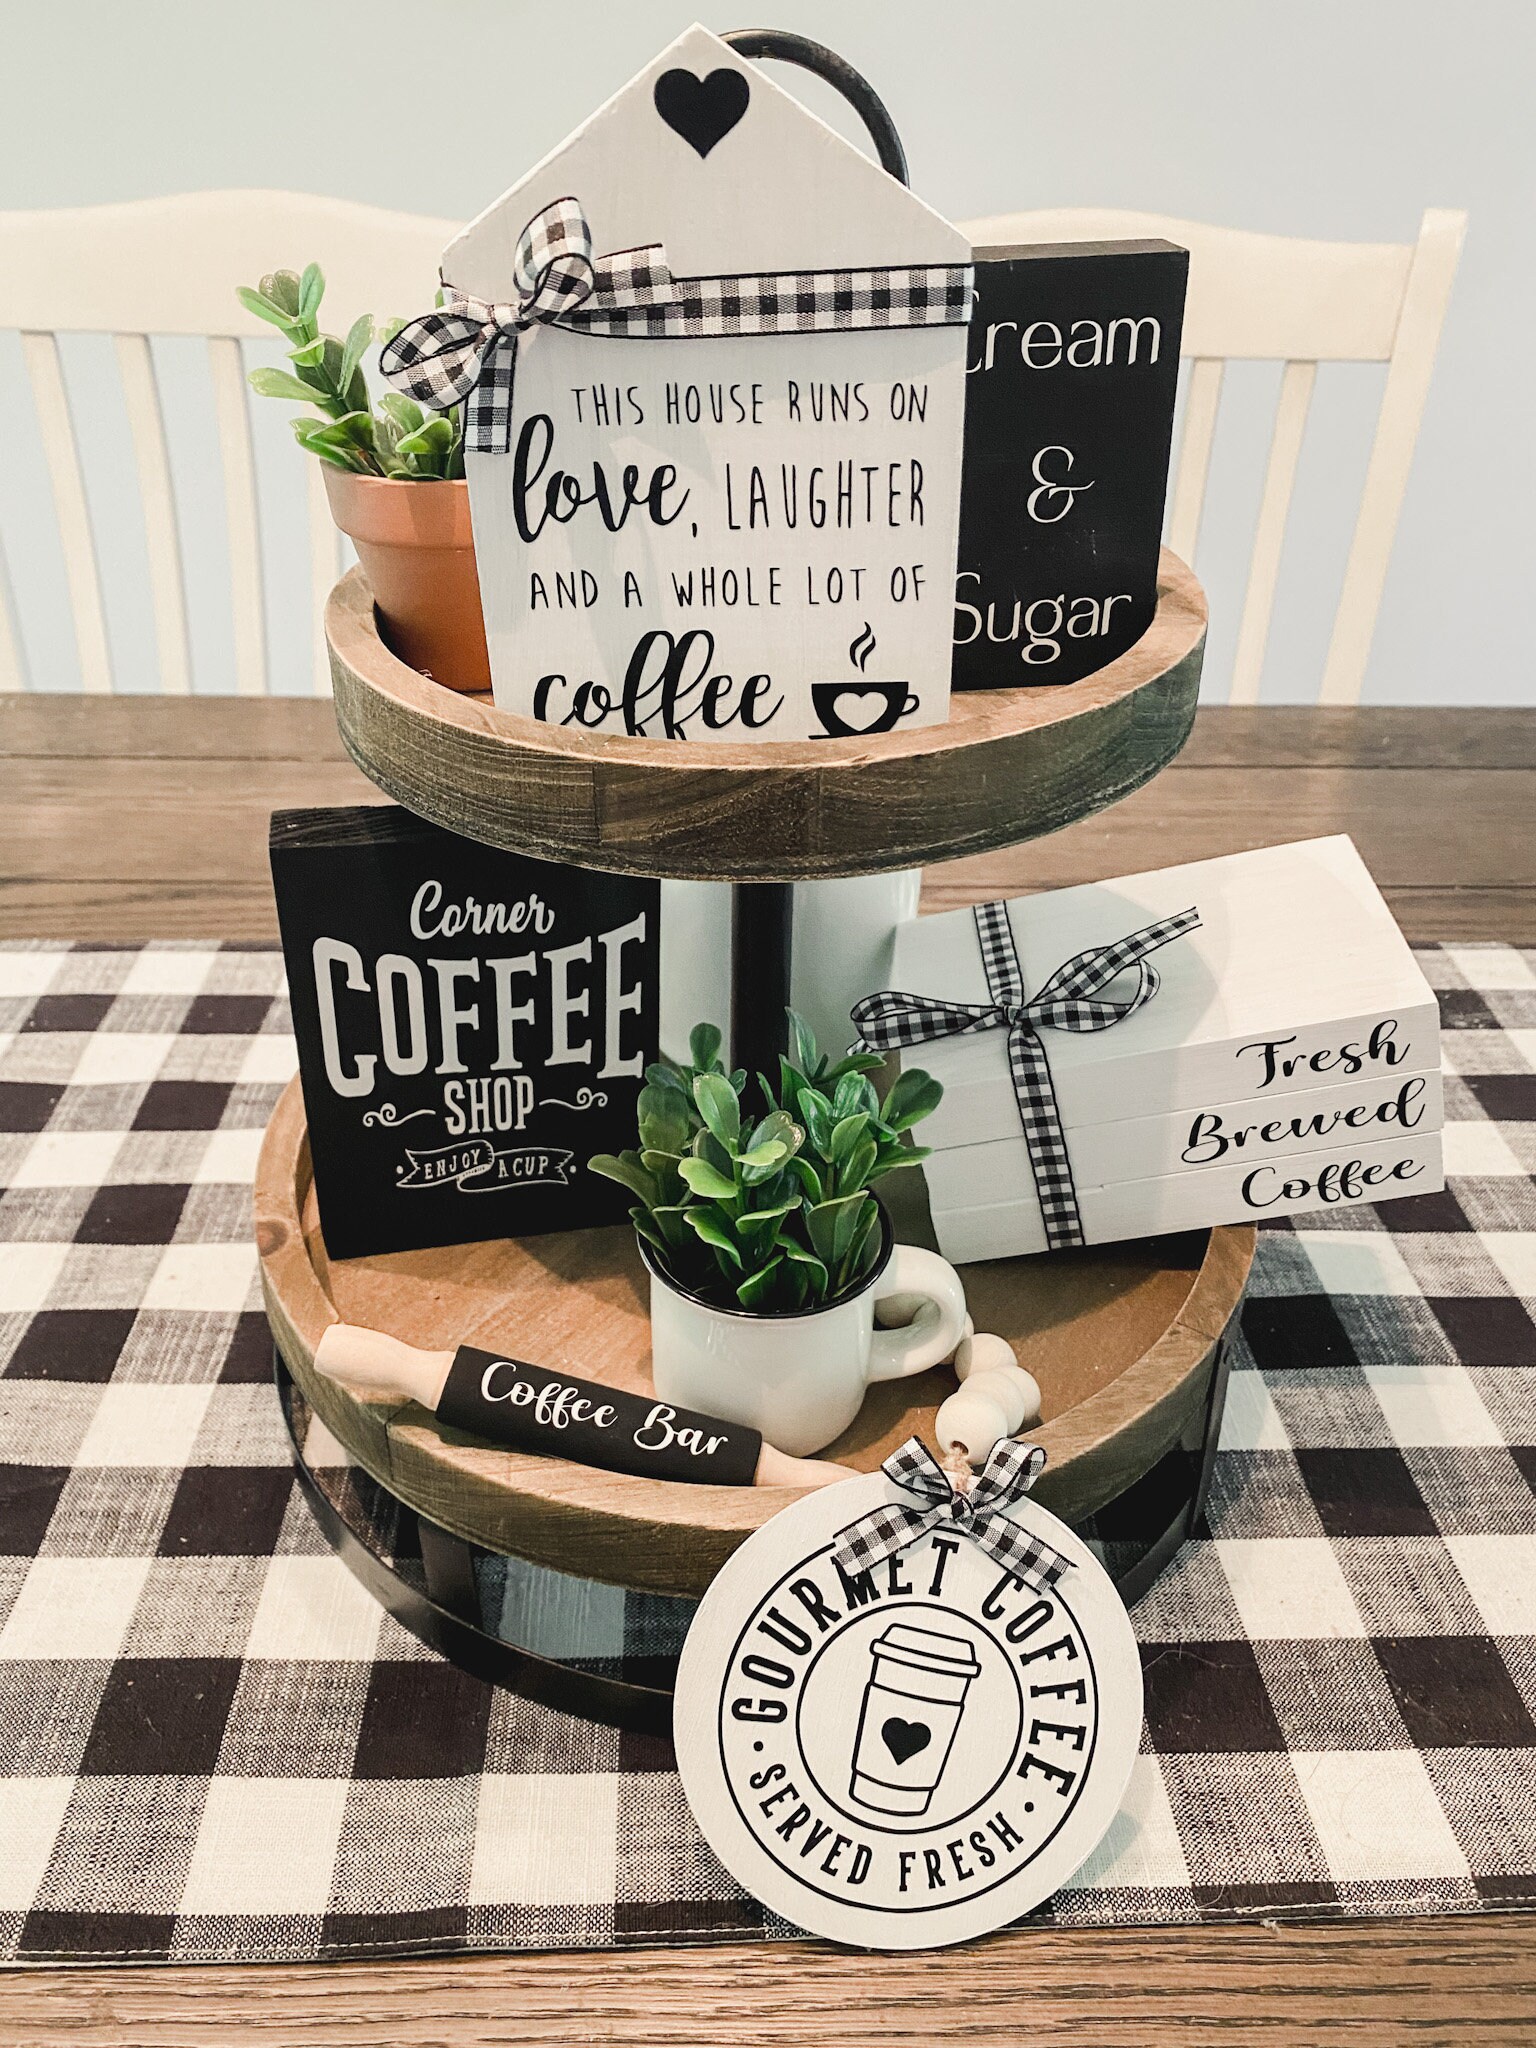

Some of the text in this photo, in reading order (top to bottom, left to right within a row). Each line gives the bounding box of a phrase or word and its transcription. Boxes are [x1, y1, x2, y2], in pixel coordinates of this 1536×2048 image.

[965, 289, 1161, 373] ream
[572, 380, 928, 426] THIS HOUSE RUNS ON
[513, 414, 924, 543] love, LAUGHTER
[1026, 445, 1095, 523] &
[531, 564, 925, 610] AND A WHOLE LOT OF
[533, 630, 785, 740] coffee
[410, 880, 555, 940] Corner
[312, 911, 646, 1097] COFFEE
[1236, 1019, 1410, 1089] Fresh
[444, 1075, 534, 1135] SHOP
[1181, 1077, 1425, 1163] Brewed
[424, 1147, 480, 1180] ENJOY
[1241, 1159, 1425, 1207] Coffee
[480, 1361, 729, 1456] Coffee Bar
[731, 1537, 1087, 1797] GOURMET COFFEE
[749, 1763, 1024, 1892] SERVED FRESH
